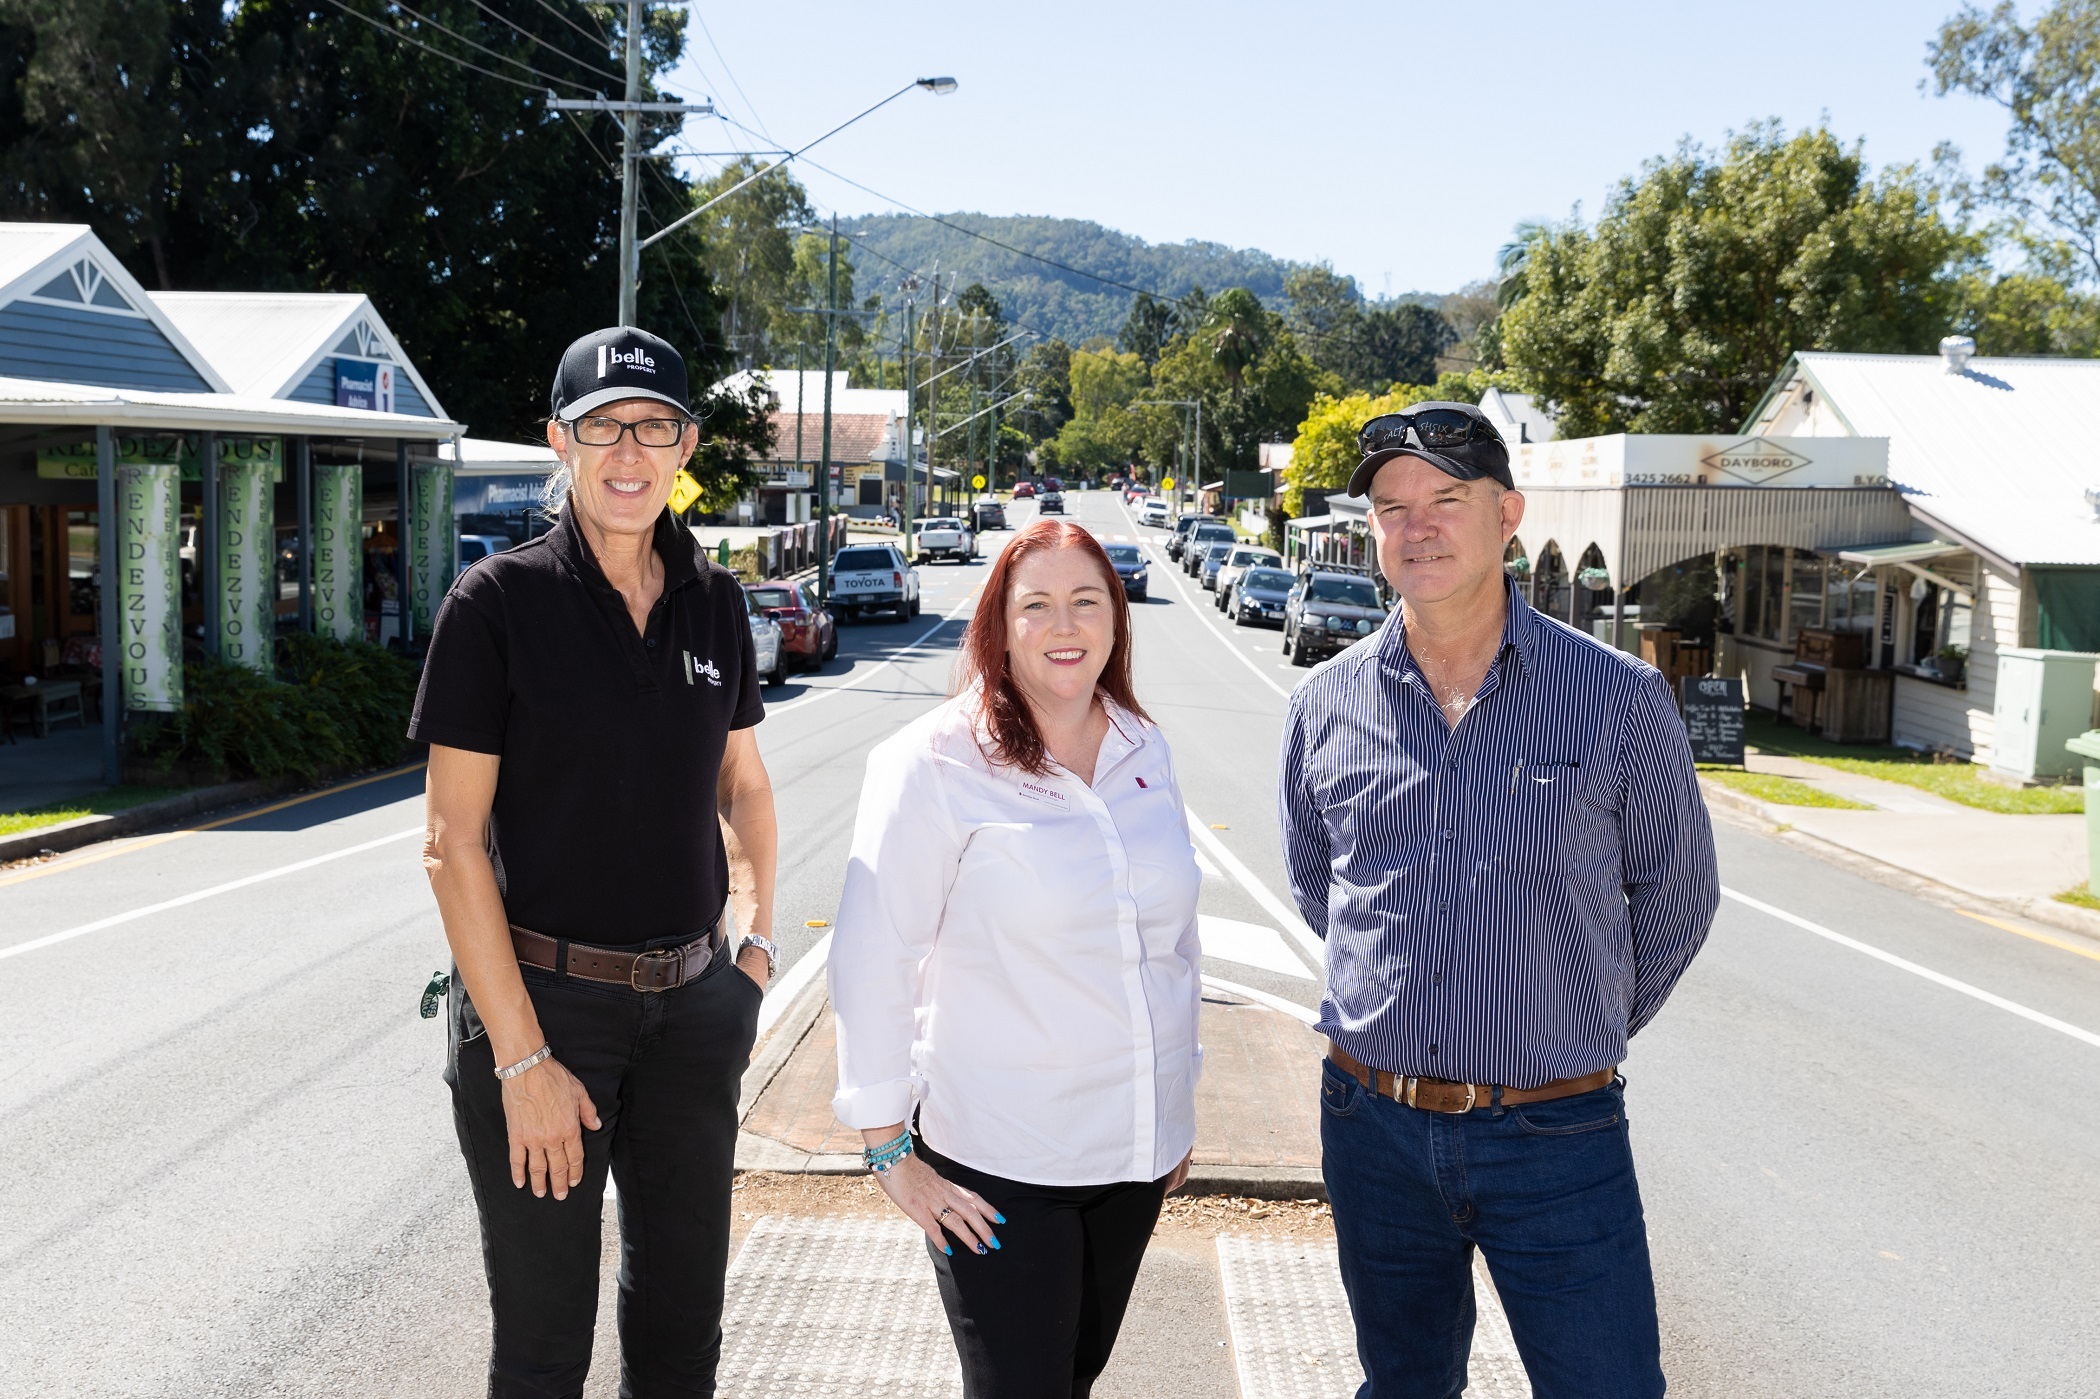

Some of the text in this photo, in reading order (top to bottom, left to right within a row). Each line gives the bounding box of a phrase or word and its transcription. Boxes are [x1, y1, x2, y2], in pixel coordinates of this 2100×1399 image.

[611, 347, 655, 367] belle
[626, 364, 656, 375] PROPERTY
[341, 375, 373, 392] Pharmacist
[348, 394, 369, 409] Advice
[47, 437, 272, 460] REDEZVUS
[1721, 457, 1793, 468] DAYBORO
[1625, 472, 1656, 484] 3425
[1660, 473, 1691, 484] 2662
[488, 483, 528, 503] Pharmacist
[227, 466, 243, 660] RENDEZVOU
[320, 469, 335, 638] RENDEZVO
[128, 468, 148, 709] RENDEZVOUS
[844, 577, 885, 588] TOYOTA
[693, 656, 720, 679] belle
[1022, 782, 1048, 795] MANDY
[1049, 790, 1066, 801] BELL
